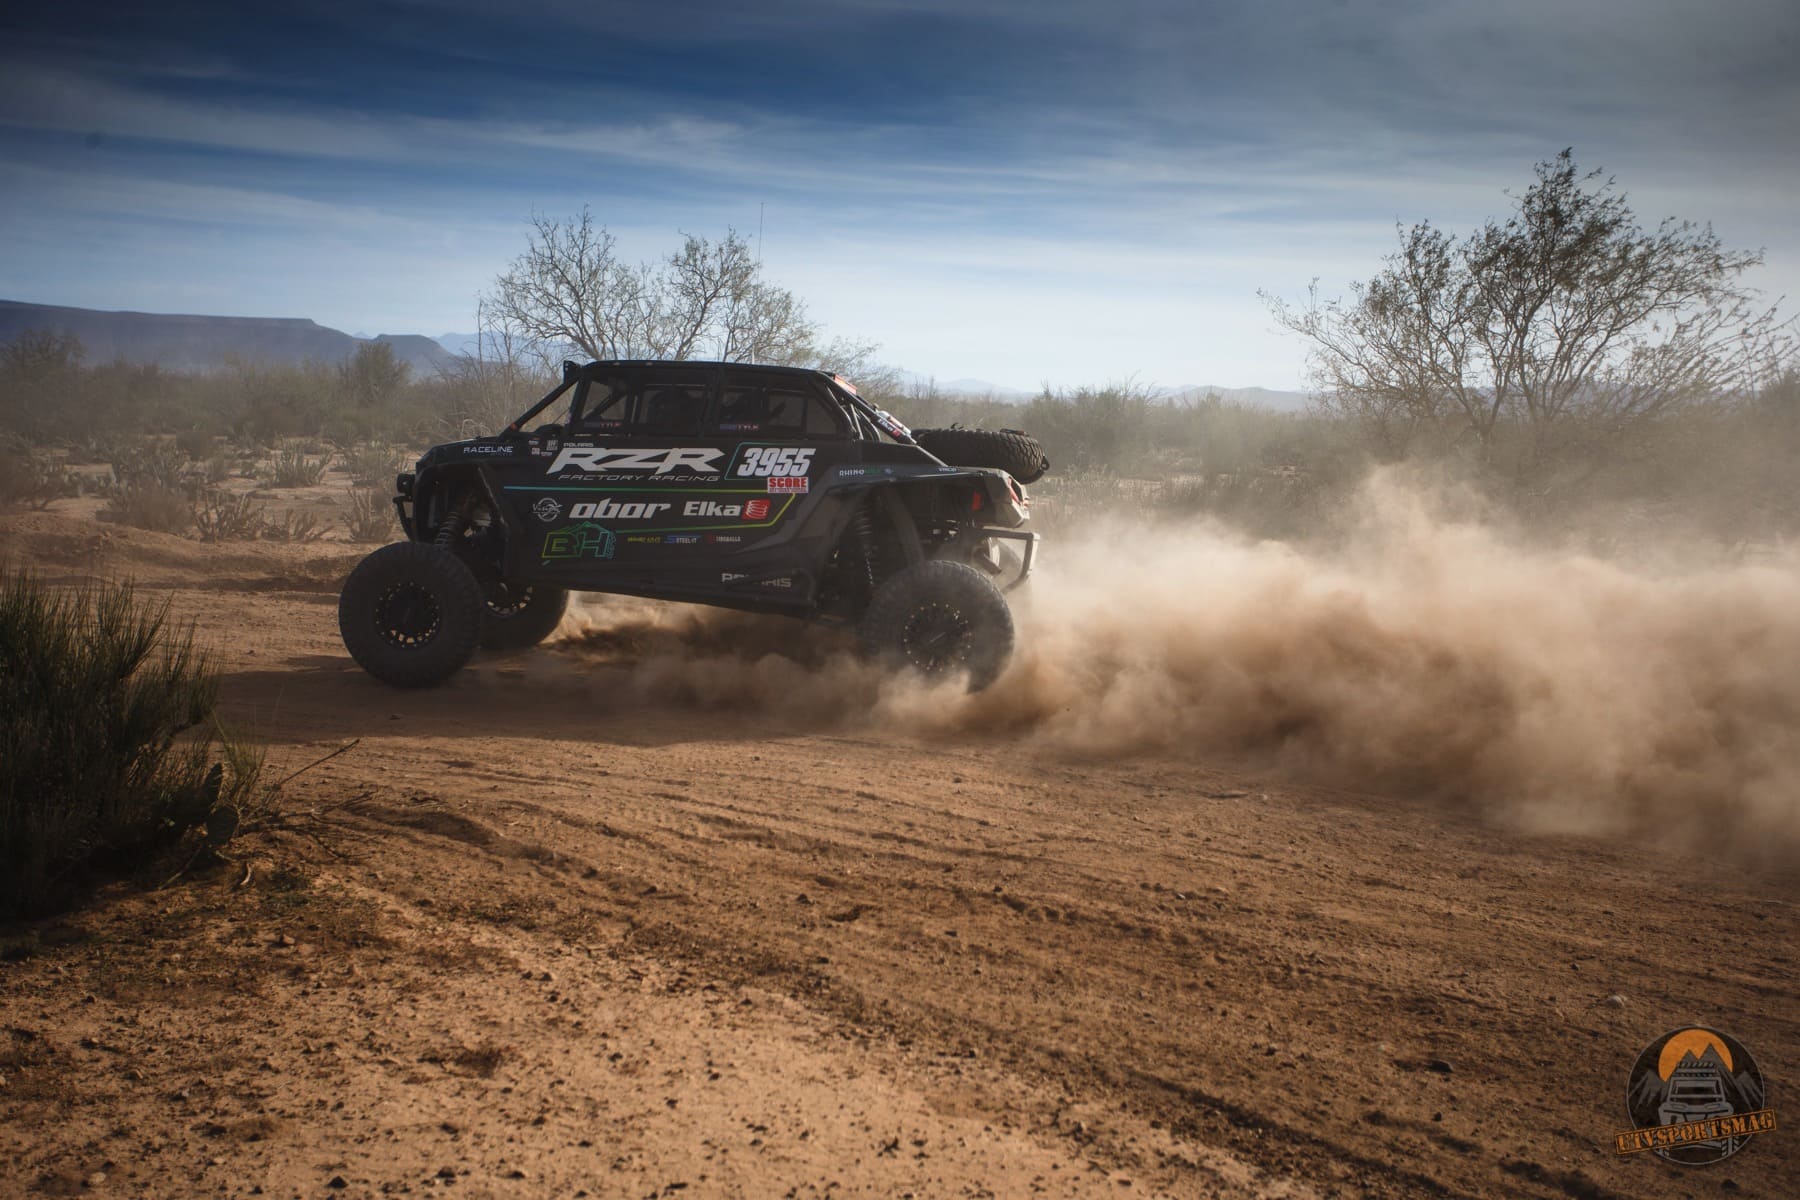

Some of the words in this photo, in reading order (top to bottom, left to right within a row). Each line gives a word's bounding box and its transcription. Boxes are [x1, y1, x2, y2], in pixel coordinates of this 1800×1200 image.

[546, 448, 726, 475] RZR
[737, 447, 817, 477] 3955
[769, 478, 807, 488] SCORE
[569, 498, 671, 518] obor
[683, 501, 742, 516] Elka
